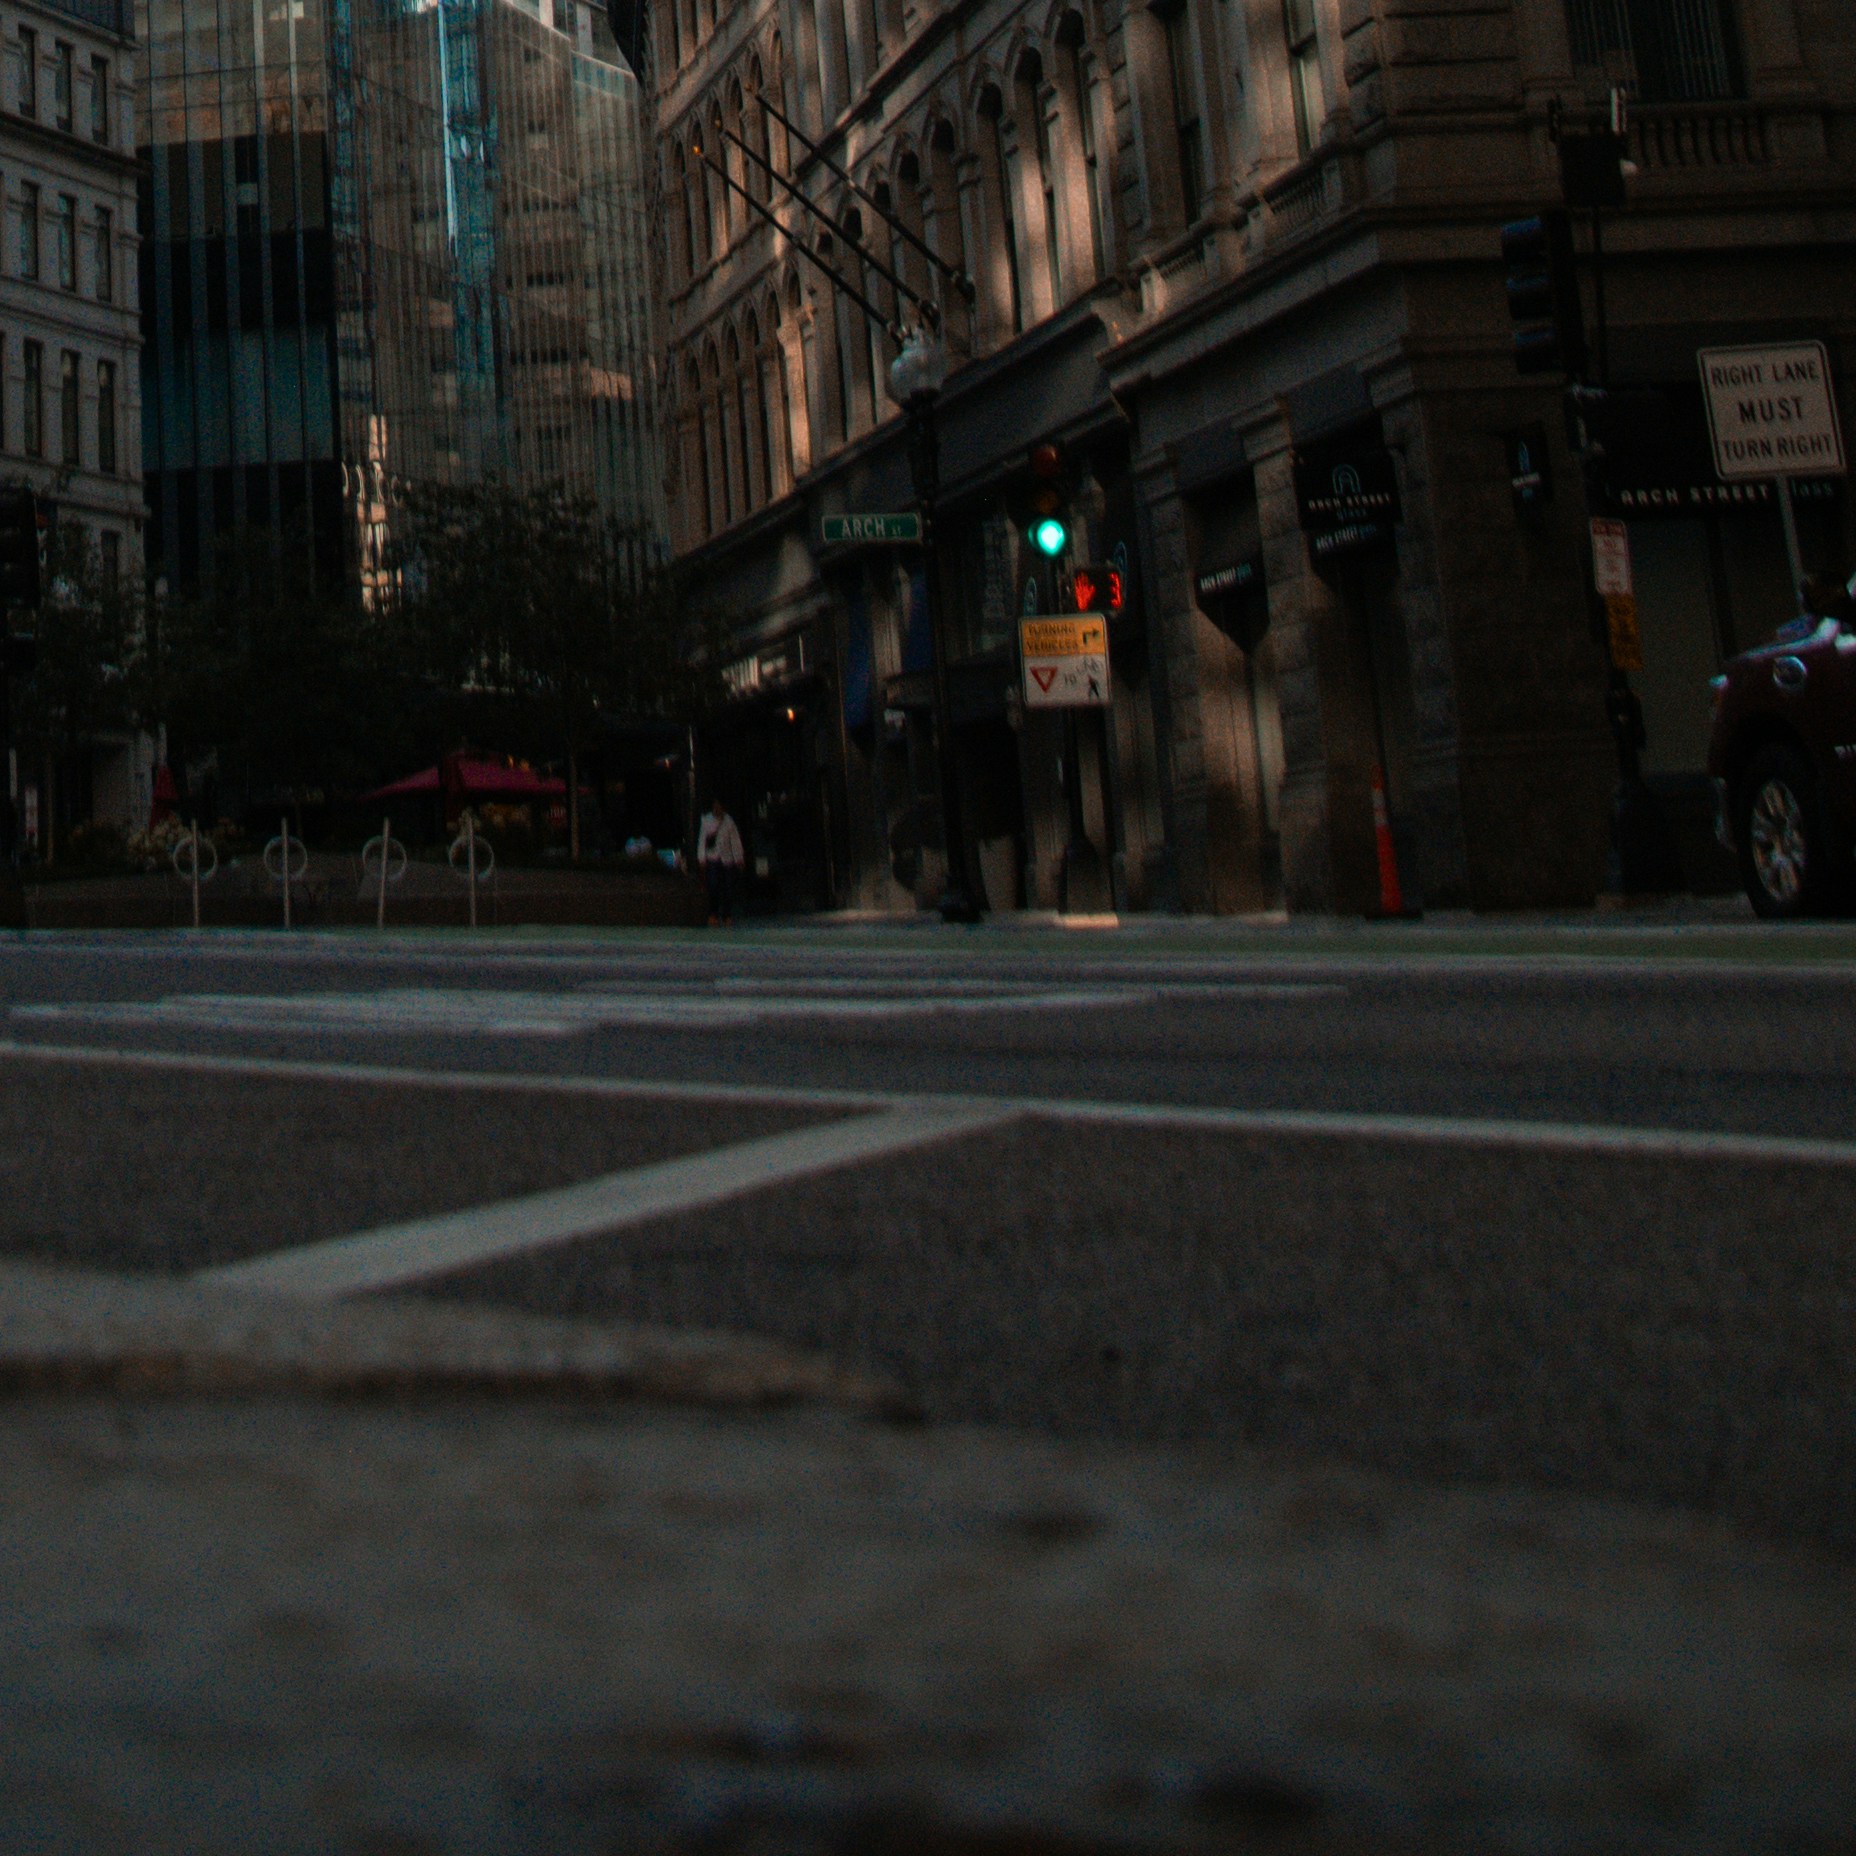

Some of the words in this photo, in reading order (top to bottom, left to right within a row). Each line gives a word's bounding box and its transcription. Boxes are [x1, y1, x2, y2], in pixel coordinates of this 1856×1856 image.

[1711, 363, 1763, 386] RIGHT
[1773, 359, 1820, 382] LANE
[1737, 395, 1805, 423] MUST
[1721, 437, 1773, 461] TURN
[1777, 433, 1834, 456] RIGHT
[1619, 487, 1681, 507] ARCH
[1689, 483, 1771, 503] STREET
[841, 515, 887, 540] ARCH
